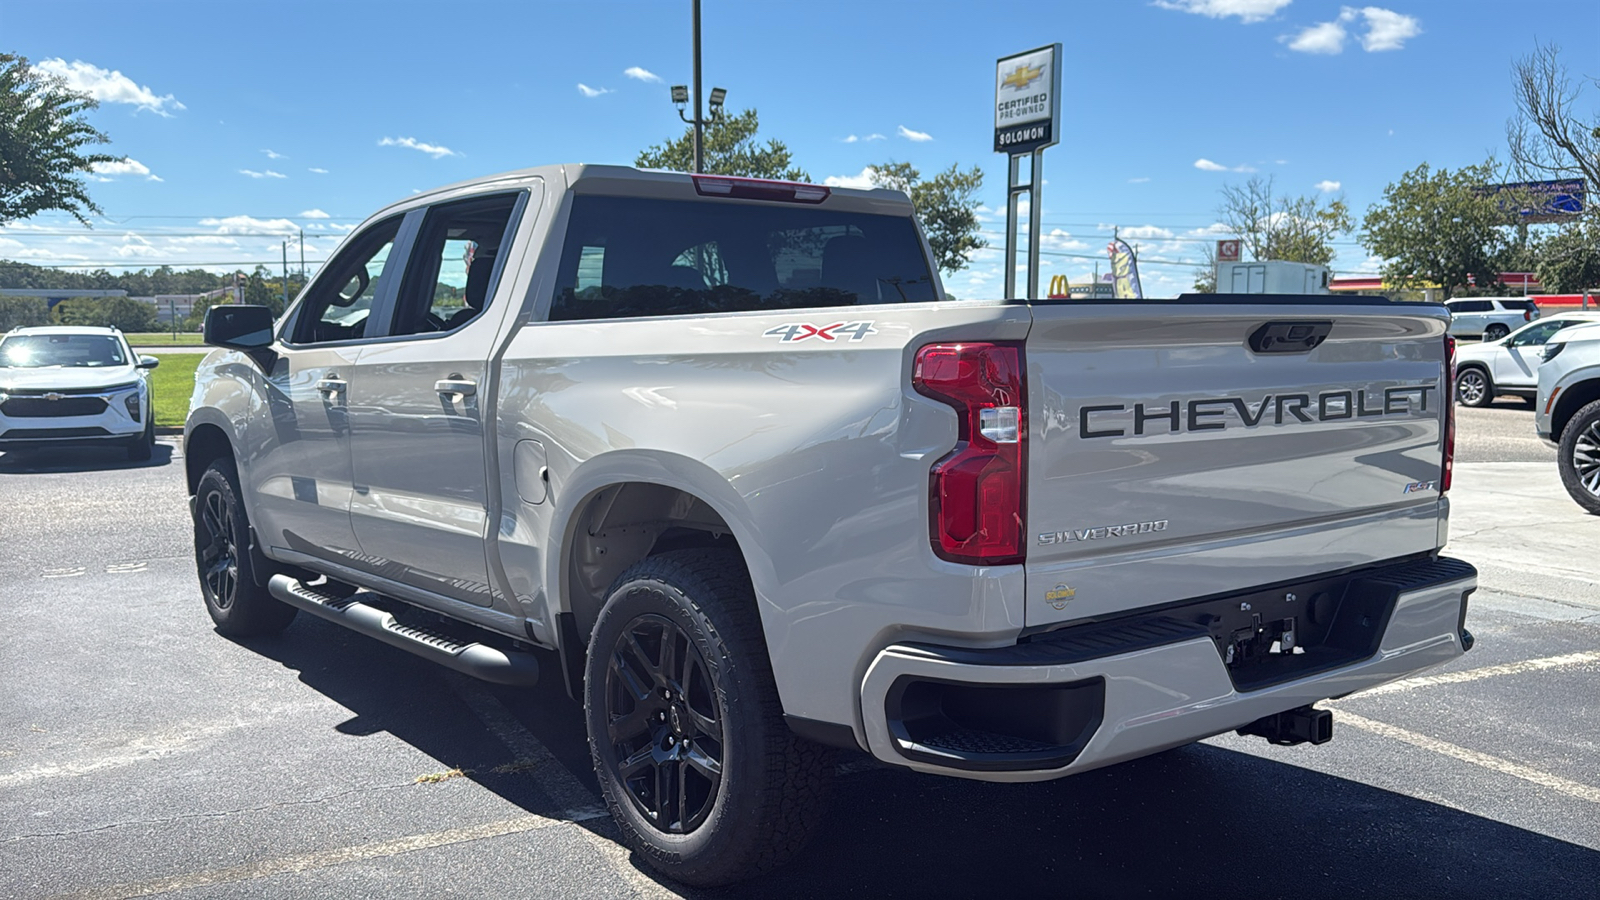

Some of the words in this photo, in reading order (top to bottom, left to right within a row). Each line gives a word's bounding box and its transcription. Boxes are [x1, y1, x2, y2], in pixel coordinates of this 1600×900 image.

[998, 93, 1047, 111] CERTIFIED
[1000, 103, 1045, 120] PRE-OWNED
[999, 127, 1044, 145] SOLOMON
[1079, 385, 1436, 440] CHEVROLET
[1038, 519, 1168, 546] SILVERADO
